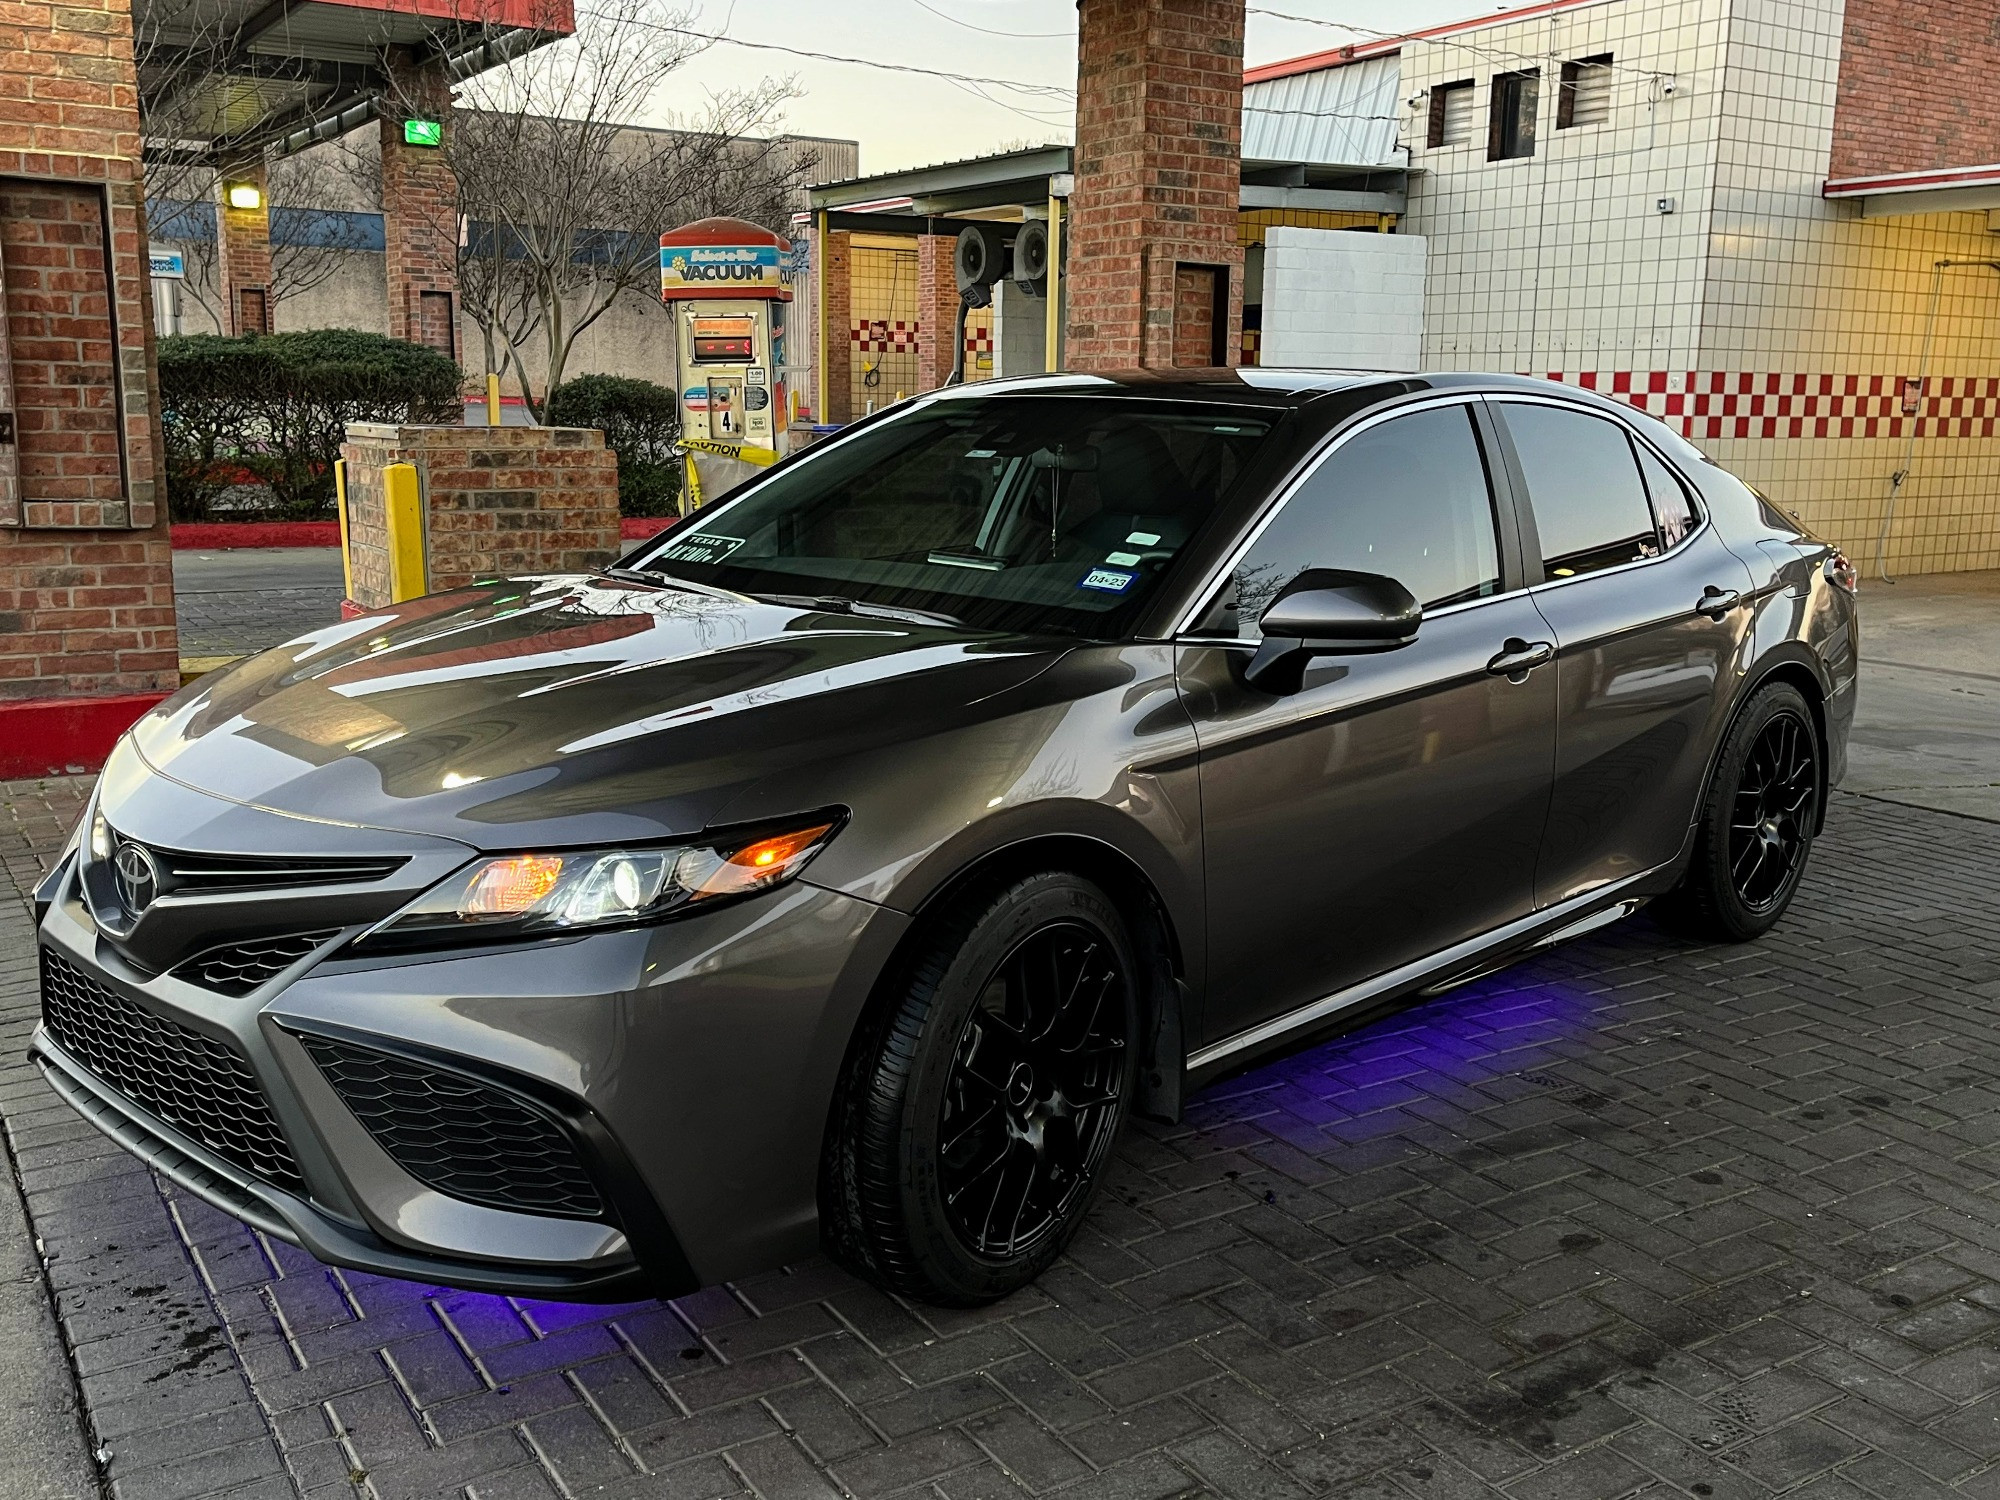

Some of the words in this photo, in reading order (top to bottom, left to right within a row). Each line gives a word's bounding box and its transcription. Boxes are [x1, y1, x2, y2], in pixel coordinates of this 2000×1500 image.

[681, 265, 763, 280] VACUUM
[722, 412, 730, 431] 4
[689, 536, 722, 546] TEXAS
